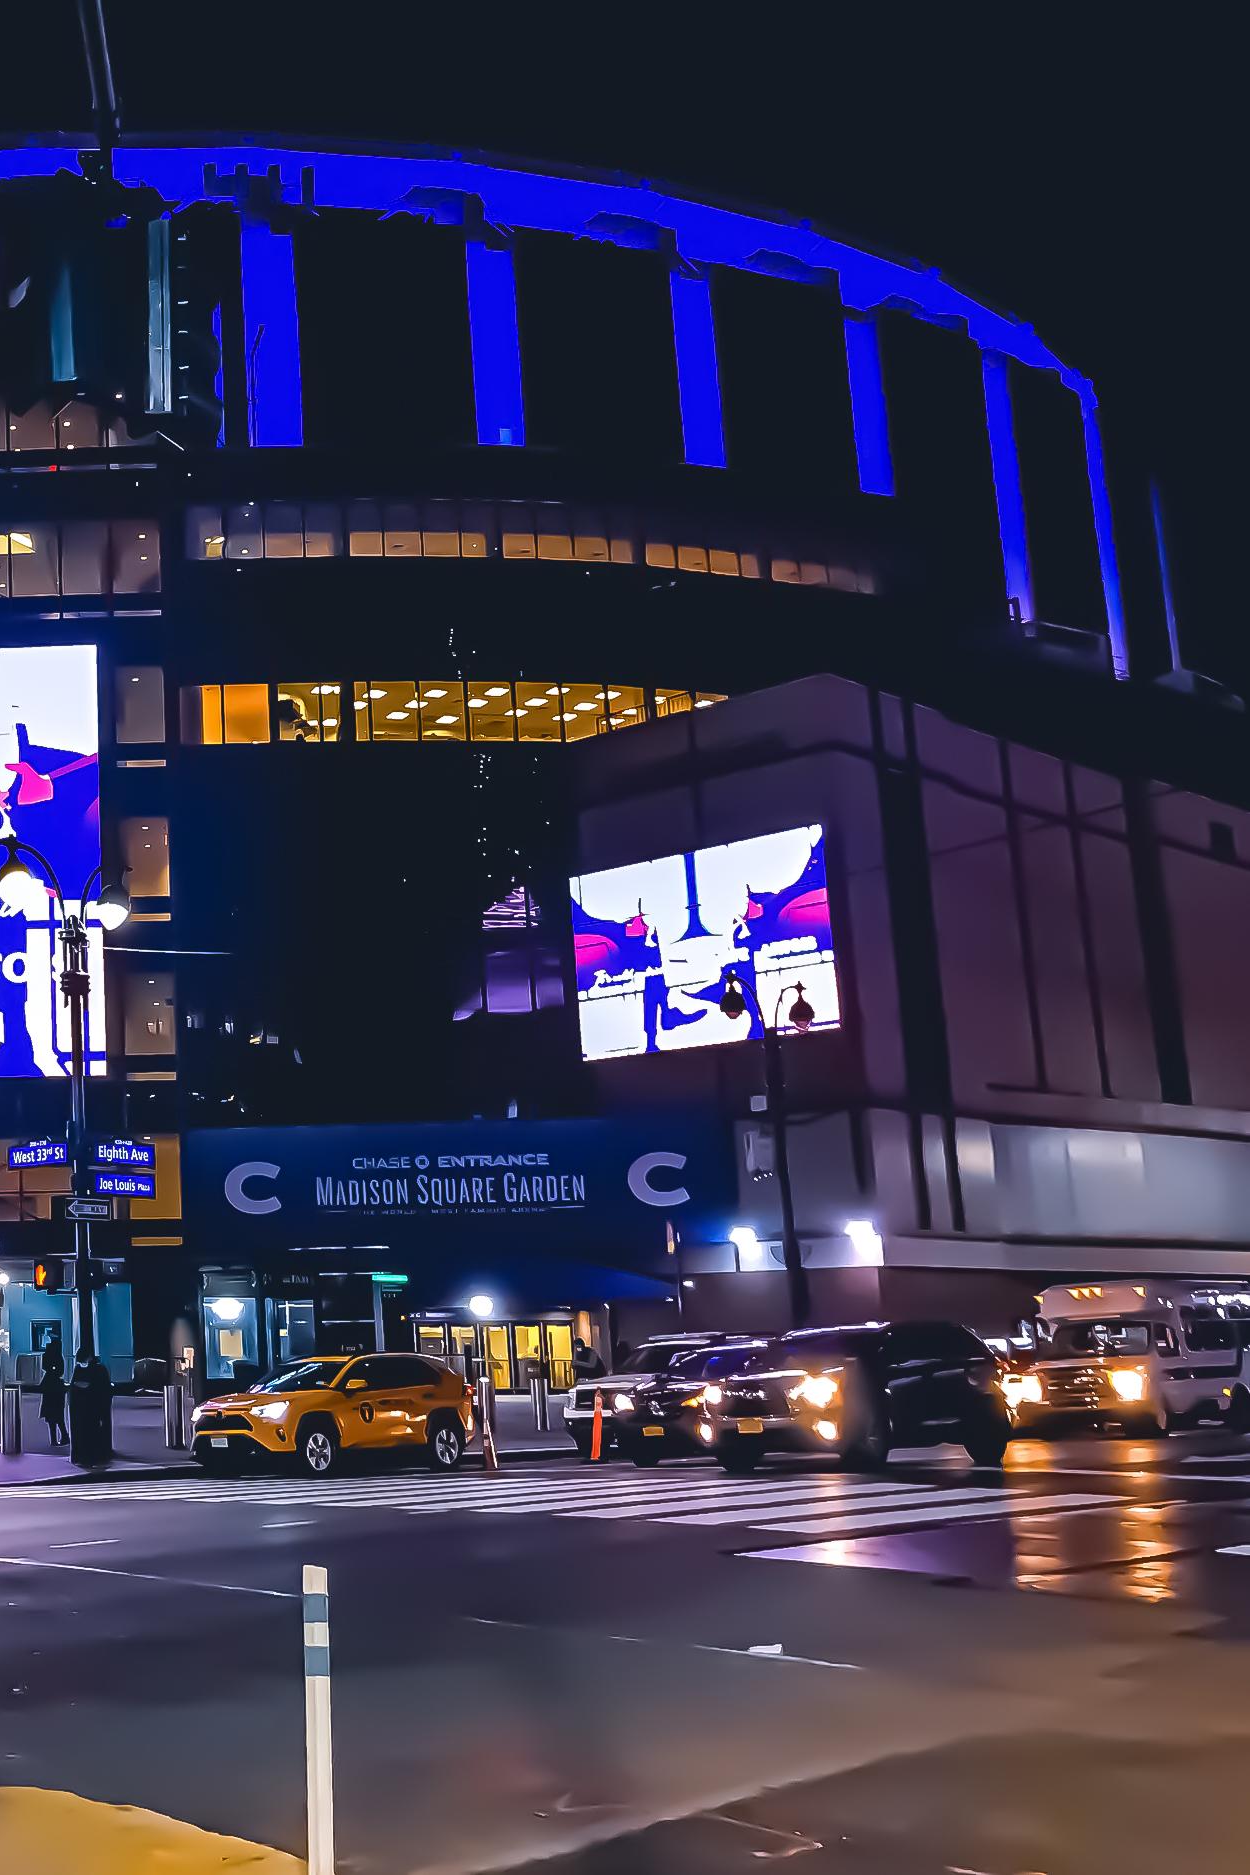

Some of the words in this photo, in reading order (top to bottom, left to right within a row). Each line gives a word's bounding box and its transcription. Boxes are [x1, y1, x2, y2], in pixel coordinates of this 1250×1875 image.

[12, 1150, 35, 1164] West
[36, 1147, 53, 1162] 33rd
[54, 1147, 64, 1160] St
[98, 1145, 129, 1162] Eighth
[131, 1148, 149, 1162] Ave
[352, 1155, 411, 1169] CHASE
[437, 1153, 550, 1168] ENTRANCE
[99, 1177, 113, 1190] Joe
[114, 1178, 136, 1191] Louis
[627, 1151, 691, 1207] C
[224, 1161, 282, 1215] C
[316, 1176, 409, 1206] MADISON
[417, 1174, 497, 1207] SQUARE
[503, 1172, 586, 1204] GARDEN
